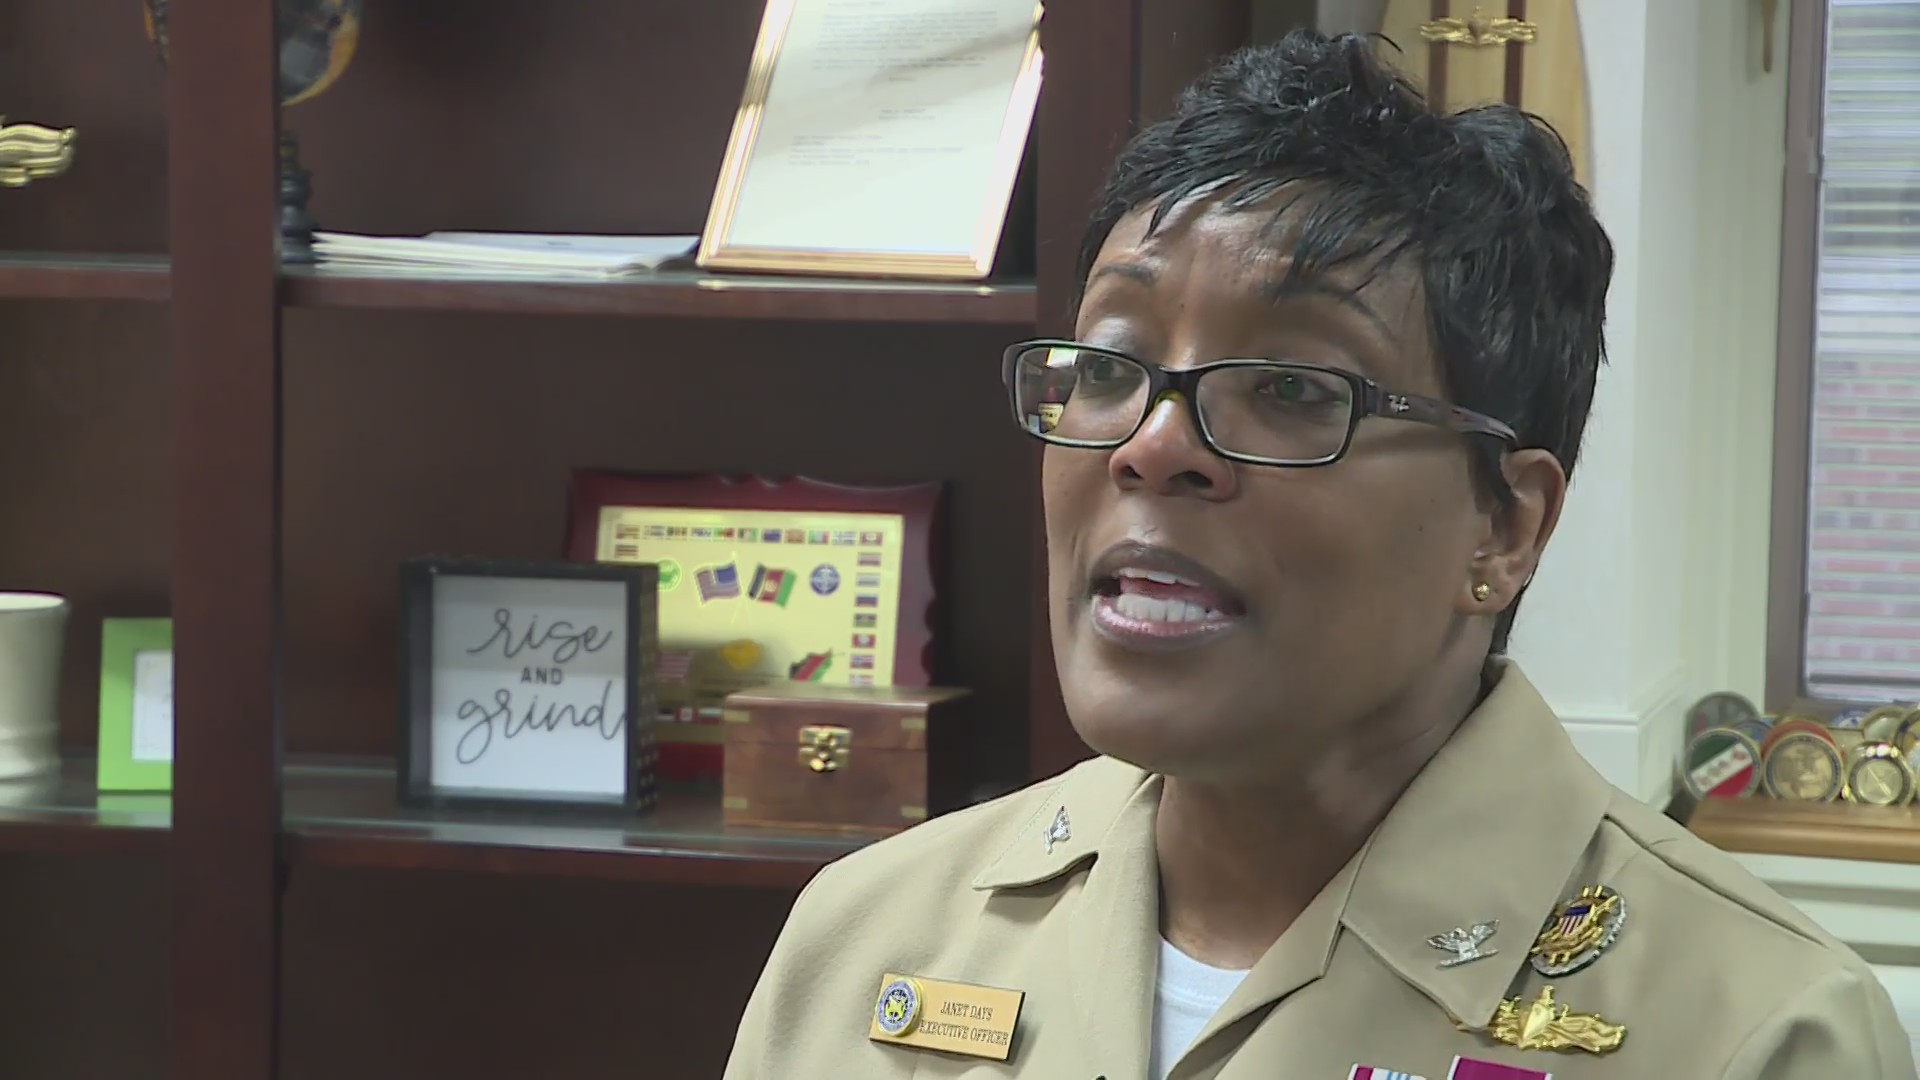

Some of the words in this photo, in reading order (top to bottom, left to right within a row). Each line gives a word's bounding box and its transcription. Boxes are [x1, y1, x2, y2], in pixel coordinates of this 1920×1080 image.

[466, 609, 613, 663] rise
[521, 667, 563, 685] AND
[457, 681, 627, 764] grind
[941, 1002, 969, 1018] JANET
[970, 1006, 993, 1021] DAYS
[920, 1020, 969, 1040] EXECUTIVE
[971, 1028, 1009, 1046] OFFICER
